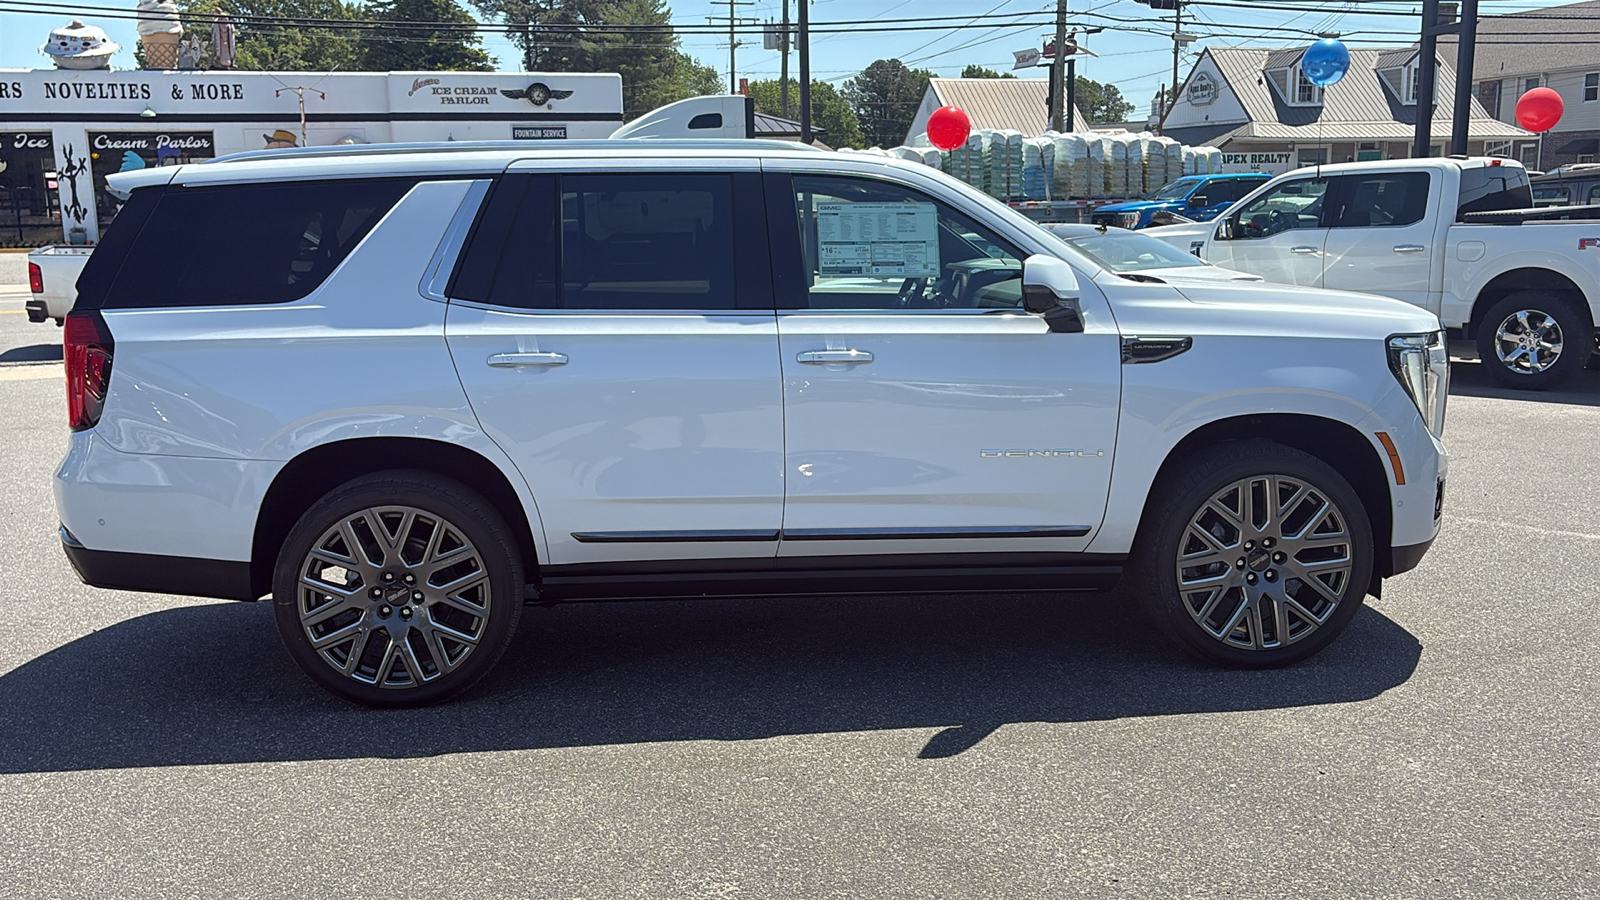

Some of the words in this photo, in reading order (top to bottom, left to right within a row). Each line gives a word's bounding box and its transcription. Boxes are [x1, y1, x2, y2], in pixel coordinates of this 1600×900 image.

[44, 82, 151, 100] NOVELTIES
[171, 84, 184, 100] &
[191, 84, 244, 100] MORE
[431, 87, 452, 95] ICE
[454, 87, 498, 95] CREAM
[440, 96, 490, 105] PARLOR
[514, 129, 542, 138] FOUNTAIN
[543, 129, 566, 138] SERVICE
[13, 133, 50, 149] Ice
[94, 134, 149, 150] Cream
[156, 134, 212, 150] Parlor
[1250, 154, 1291, 164] REALTY
[980, 448, 1104, 459] DENALI
[387, 587, 409, 602] GMC
